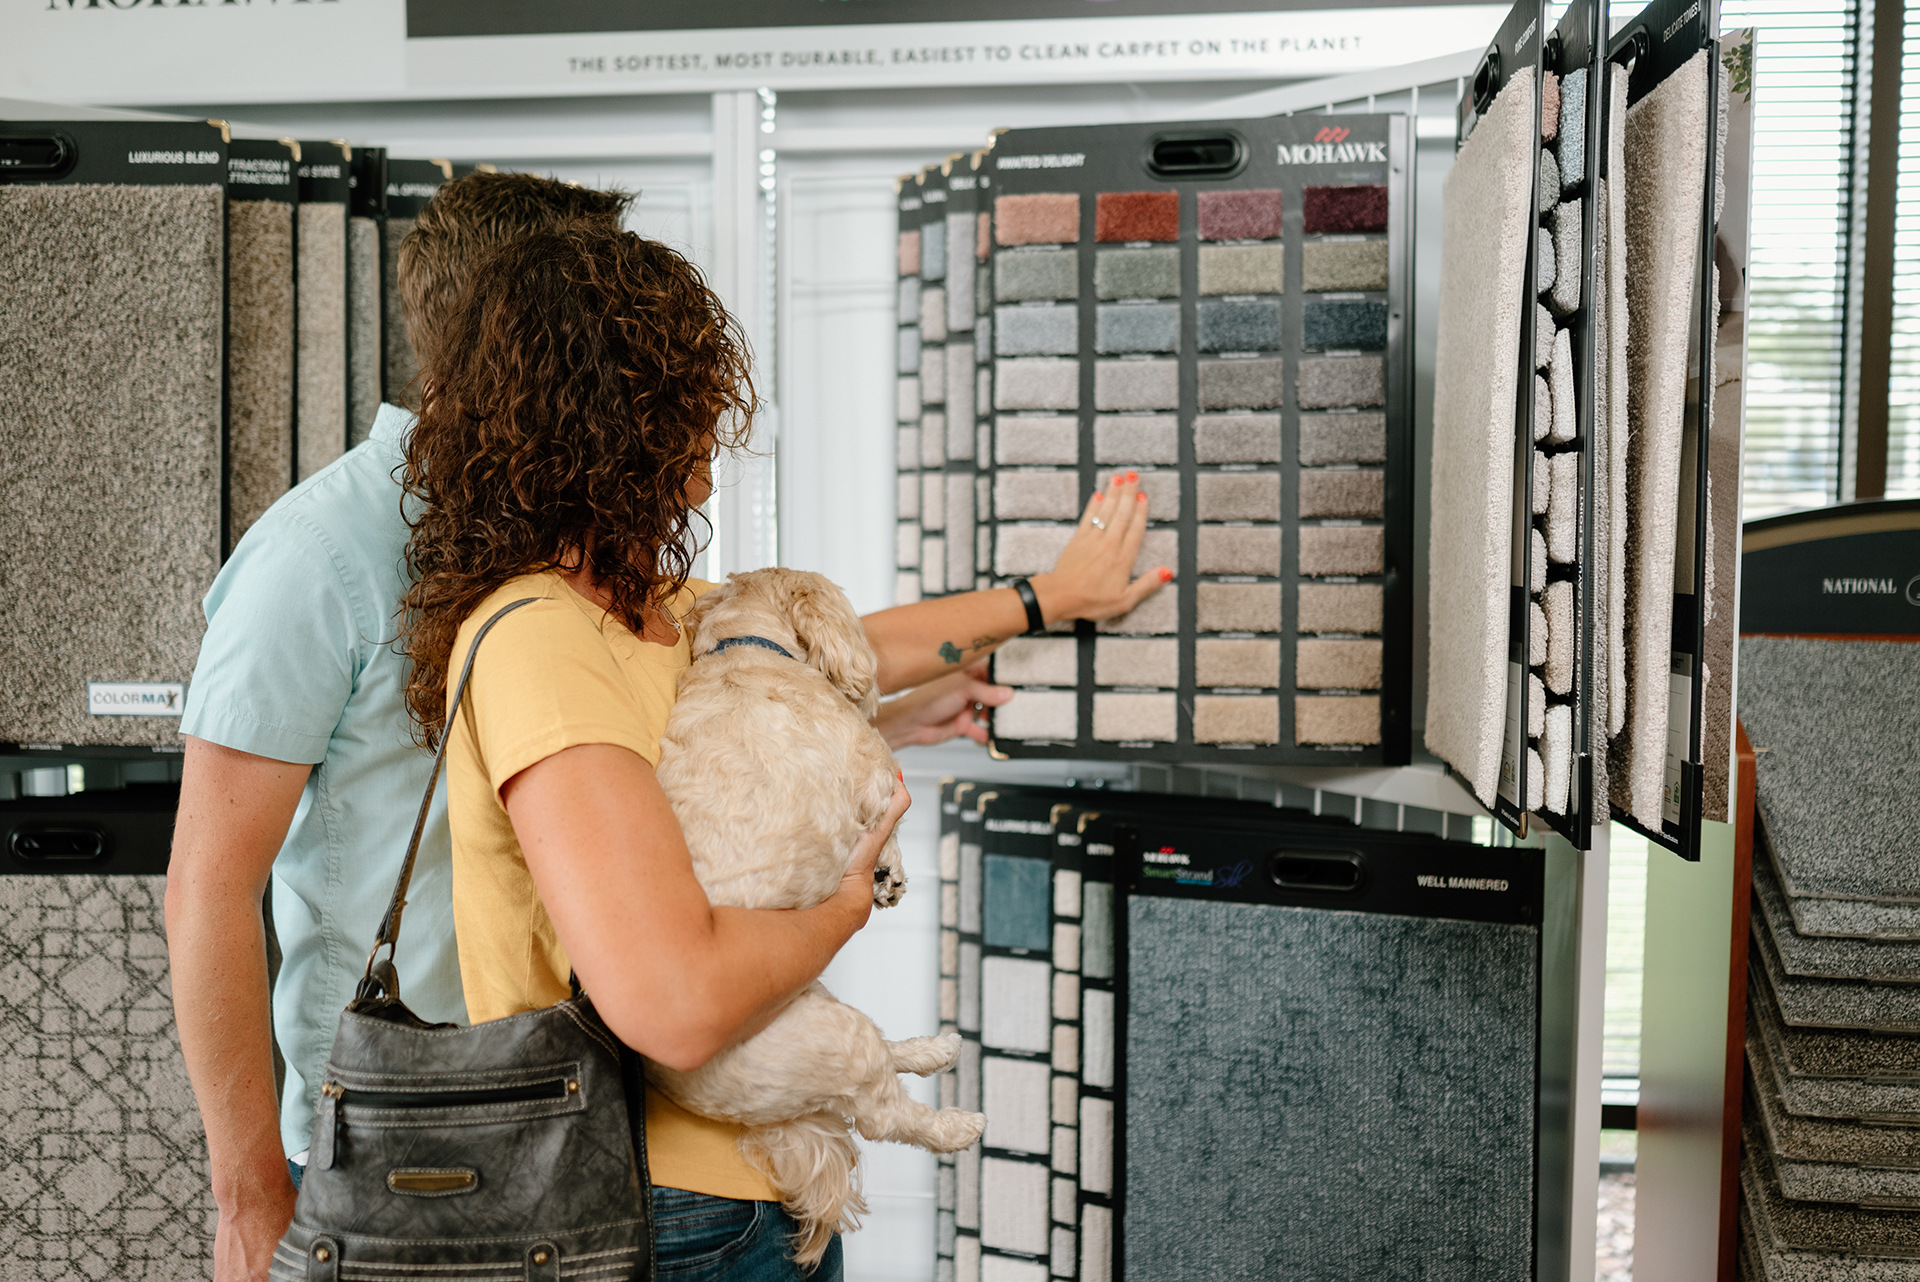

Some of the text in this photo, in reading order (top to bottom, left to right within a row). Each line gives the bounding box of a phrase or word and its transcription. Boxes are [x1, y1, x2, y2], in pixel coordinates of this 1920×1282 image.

[569, 35, 1364, 72] THE SOFTEST, MOST DURABLE, EASIEST TO CLEAN CARPET ON THE PLANET
[128, 151, 220, 164] LUXURIOUS BLEND
[1042, 152, 1087, 168] DELIGHT
[1277, 141, 1388, 165] MOHAWK
[228, 172, 284, 185] TTRACTION
[310, 164, 341, 178] STATE
[1822, 578, 1897, 594] NATIONAL
[1417, 875, 1509, 892] WELL MANNERED
